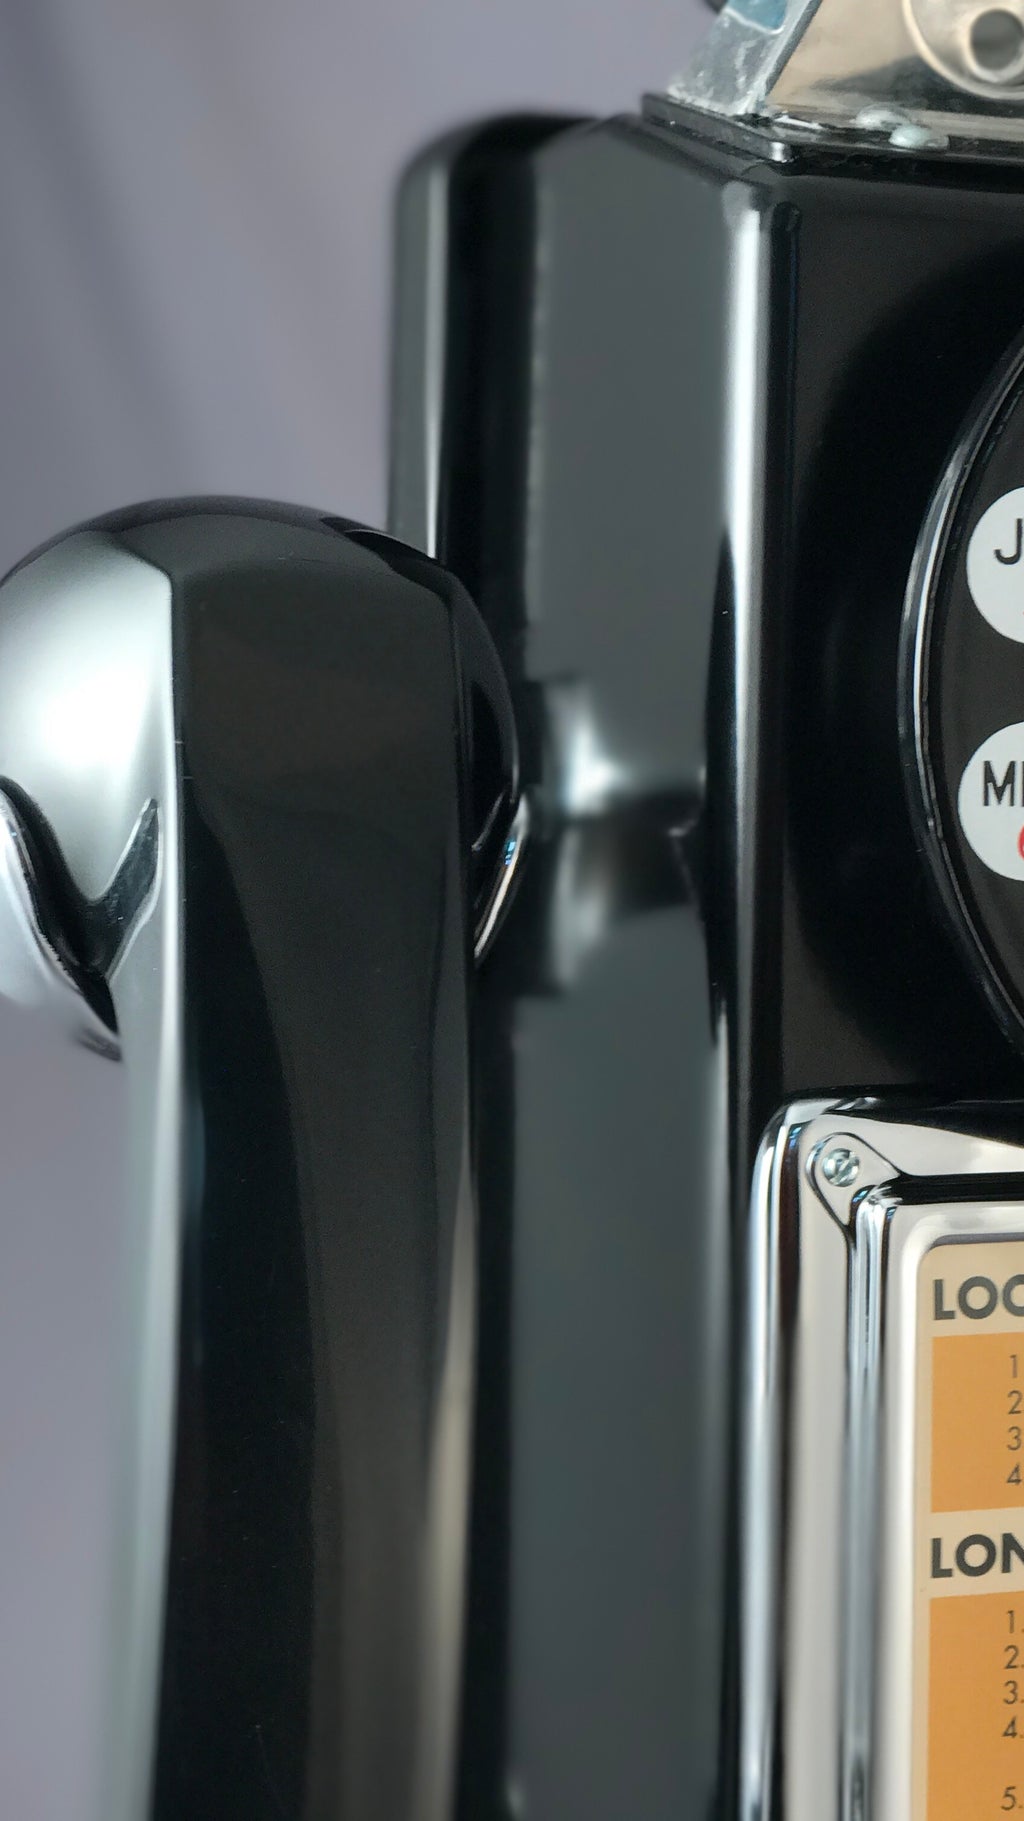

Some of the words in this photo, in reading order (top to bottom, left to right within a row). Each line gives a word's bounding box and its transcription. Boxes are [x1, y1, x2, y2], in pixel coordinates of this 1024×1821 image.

[1003, 1680, 1024, 1705] 3.
[1002, 1716, 1024, 1739] 4.
[1000, 1786, 1023, 1810] 5.
